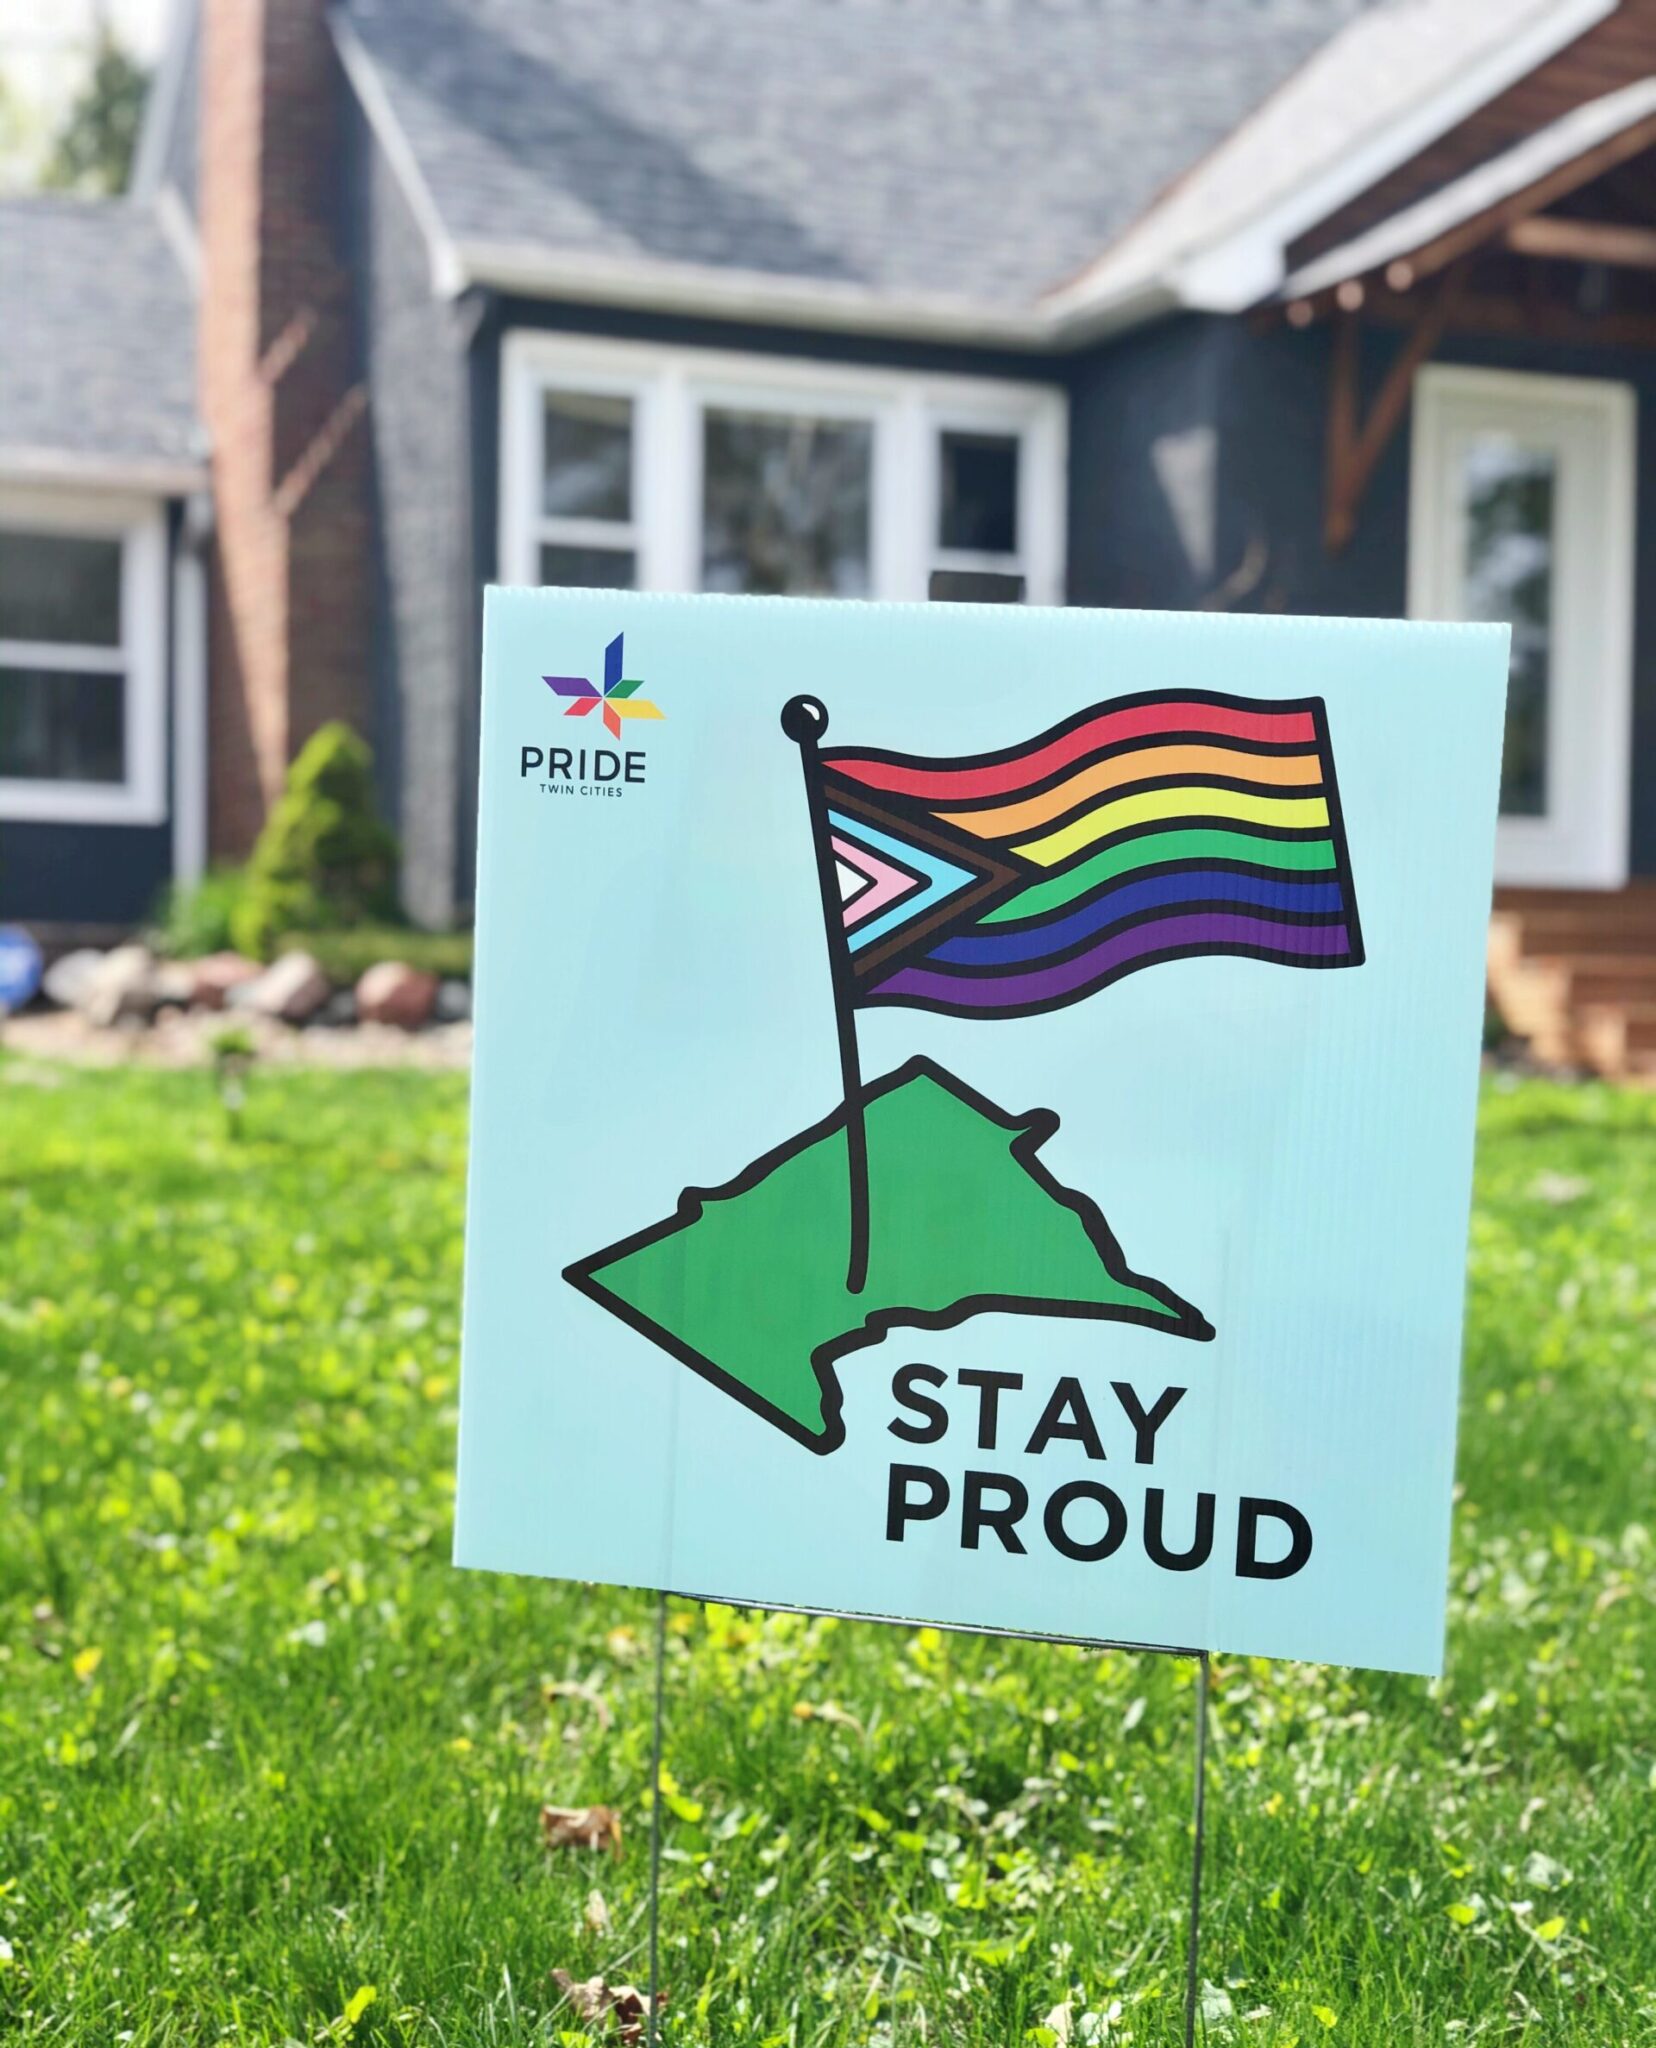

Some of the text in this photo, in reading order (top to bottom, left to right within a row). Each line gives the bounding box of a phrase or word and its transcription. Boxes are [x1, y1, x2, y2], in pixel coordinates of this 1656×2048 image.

[521, 746, 646, 783] PRIDE
[539, 783, 623, 798] TWIN CITIES
[887, 1363, 1188, 1465] STAY
[886, 1462, 1313, 1580] PROUD
